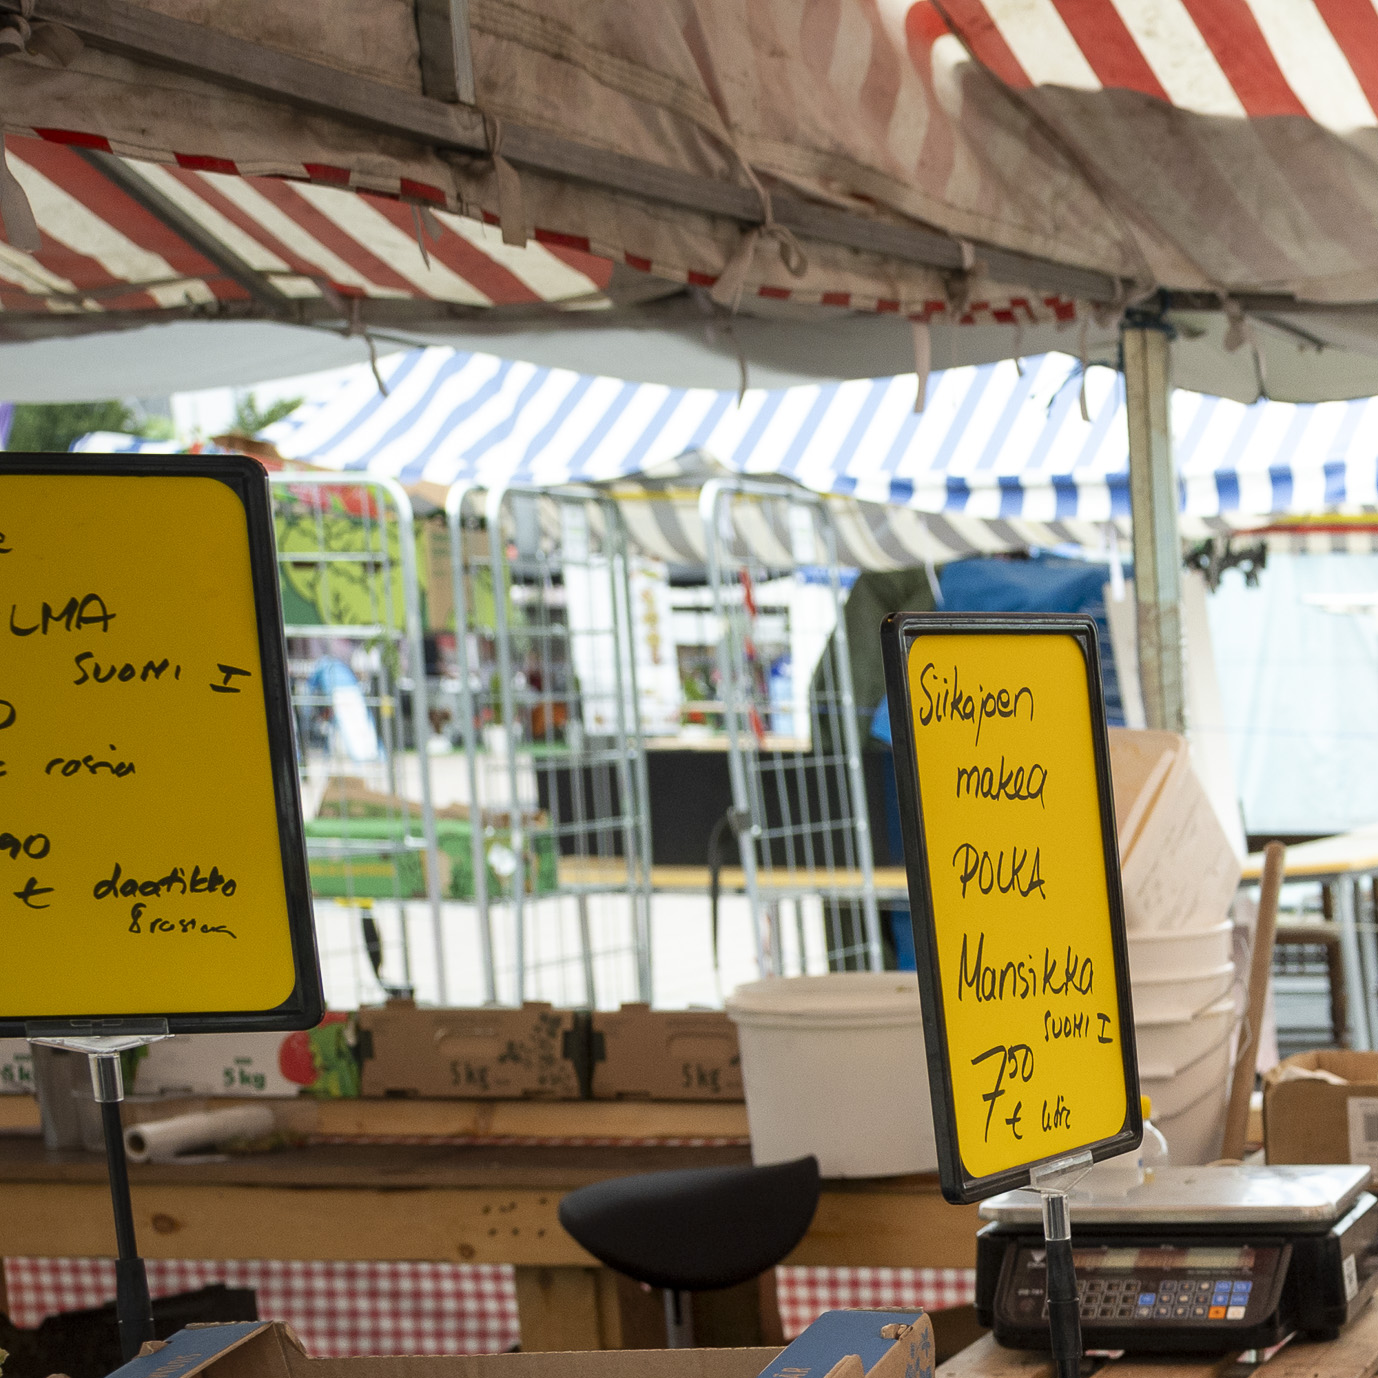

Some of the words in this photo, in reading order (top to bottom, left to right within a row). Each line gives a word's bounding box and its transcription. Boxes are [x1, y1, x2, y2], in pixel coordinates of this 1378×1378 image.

[73, 651, 181, 685] SUOMI
[956, 756, 1047, 809] makea
[953, 843, 1046, 899] POLKA
[958, 933, 1094, 1003] Mansikka
[1044, 1010, 1090, 1042] SUOMI
